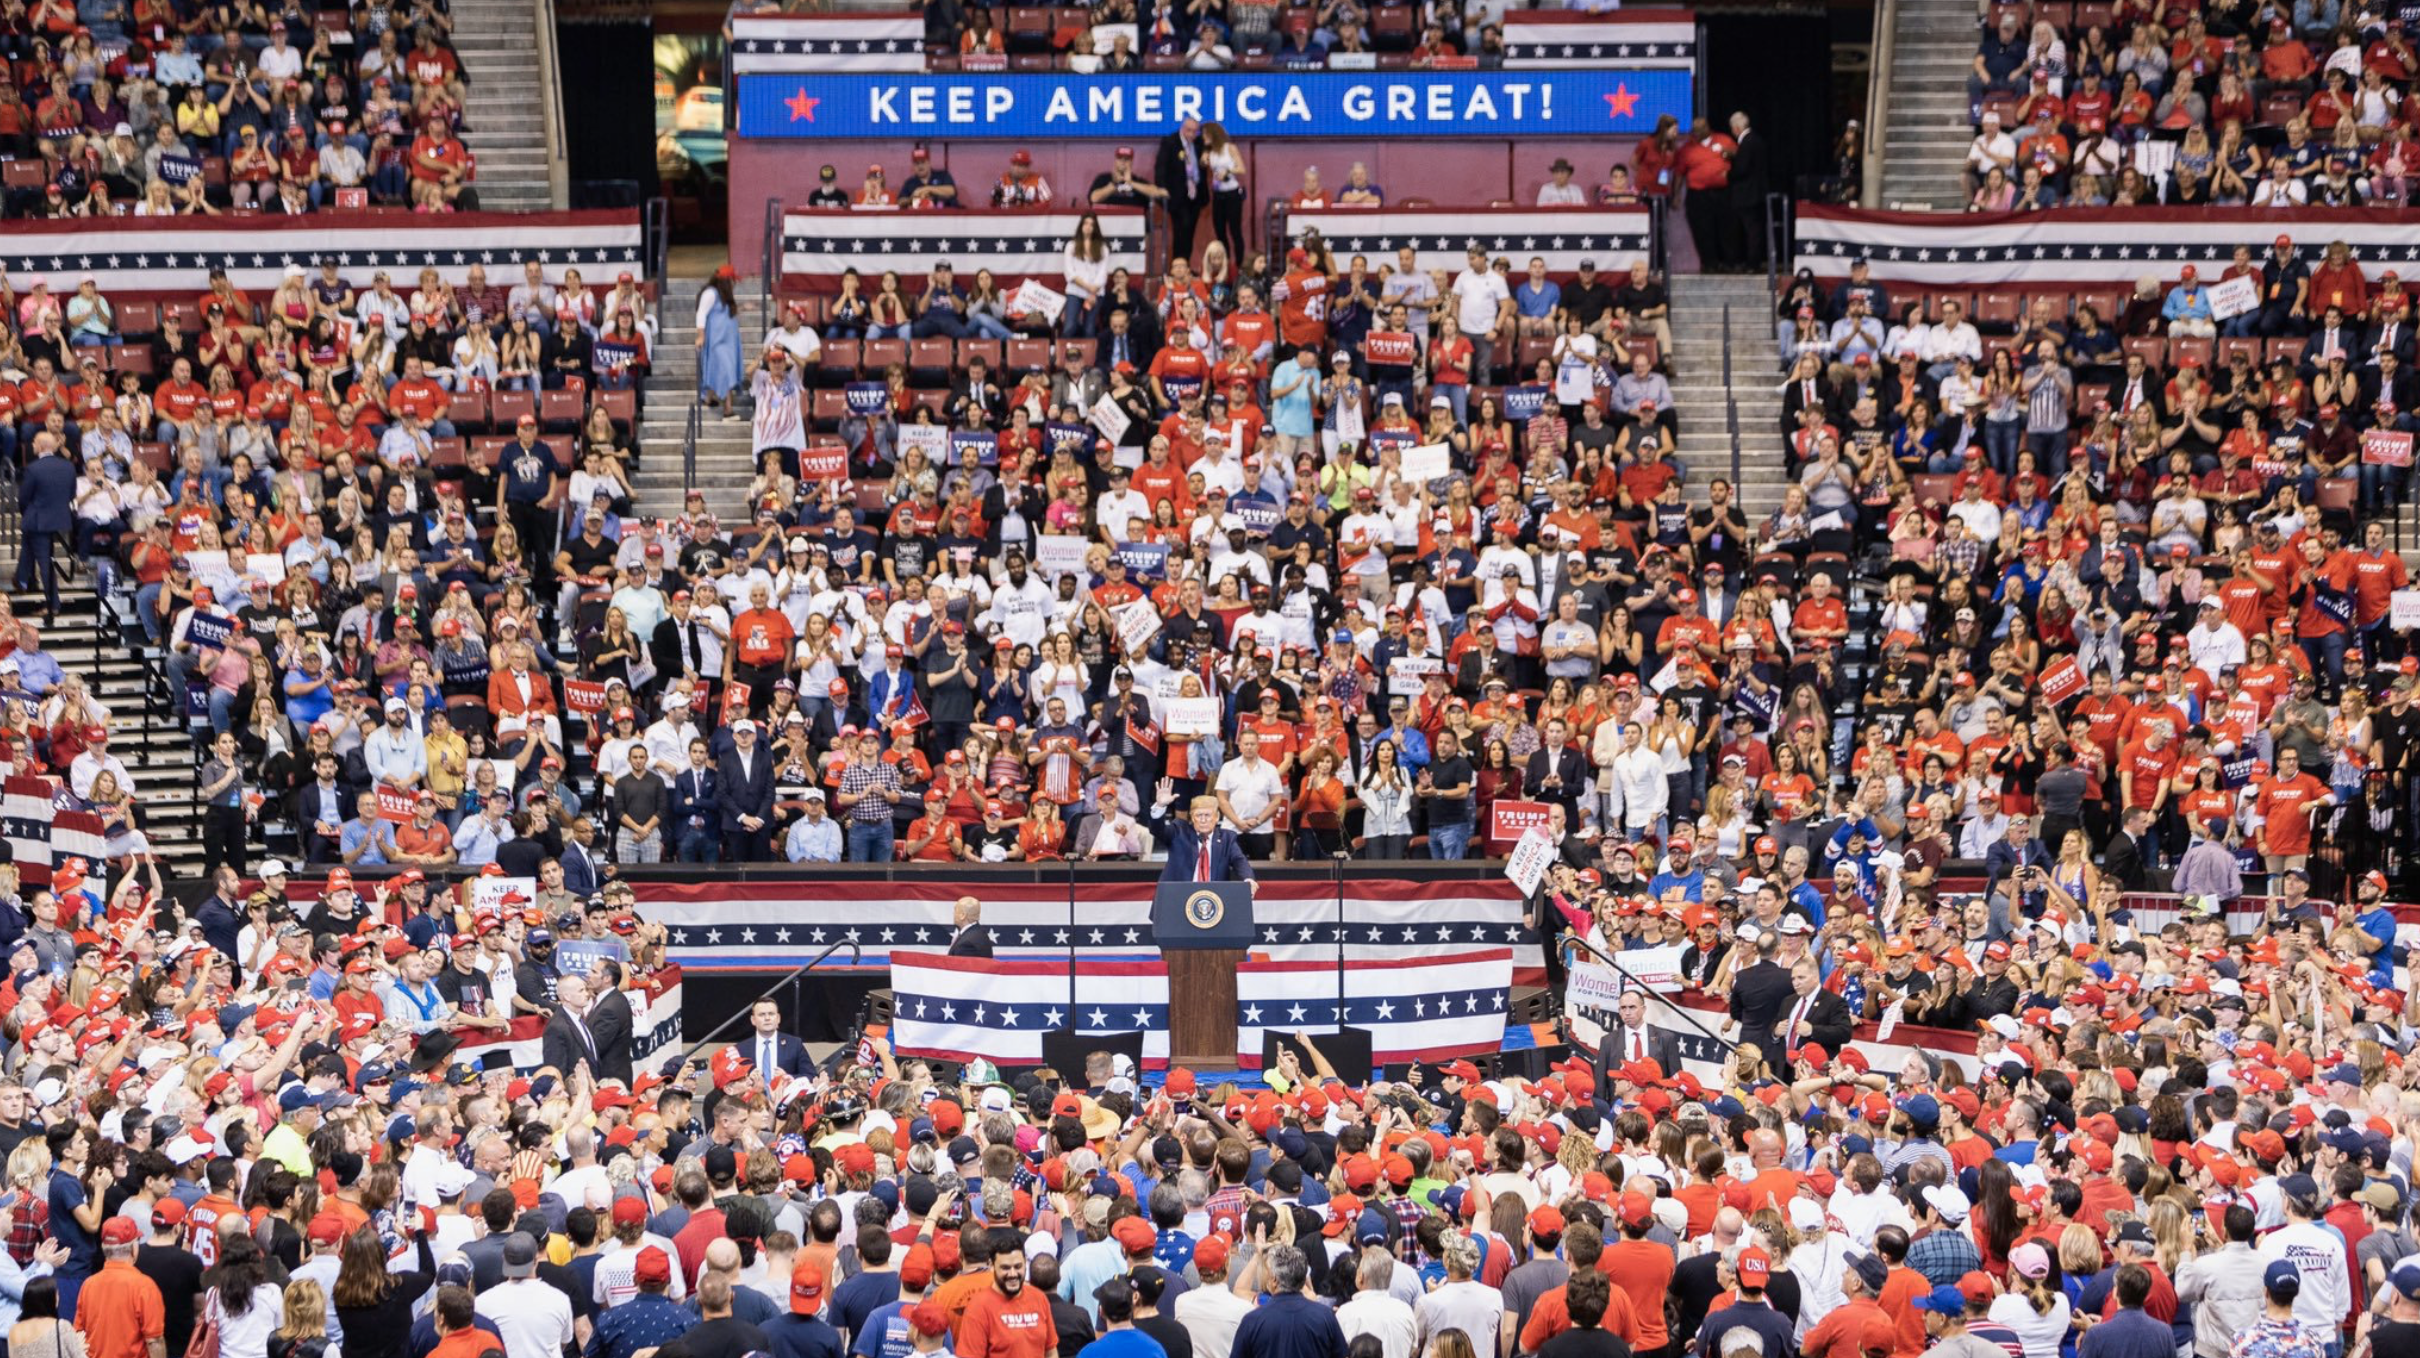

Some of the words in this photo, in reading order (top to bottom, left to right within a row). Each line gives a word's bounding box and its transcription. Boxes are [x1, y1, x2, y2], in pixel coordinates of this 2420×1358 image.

[871, 86, 1013, 122] KEEP
[1045, 85, 1311, 121] AMERICA
[1342, 83, 1551, 120] GREAT!
[163, 160, 199, 175] TRUMP
[1370, 339, 1409, 350] TRUMP
[848, 390, 885, 399] TRUMP
[1507, 393, 1547, 402] TRUMP
[902, 437, 943, 445] AMERICA
[2367, 438, 2408, 450] TRUMP
[804, 455, 844, 466] TRUMP
[1236, 509, 1277, 519] TRUMP
[1040, 545, 1082, 557] Women
[1119, 551, 1161, 559] TRUMP
[1124, 609, 1139, 625] KEEP
[193, 618, 230, 636] TRUMP
[1129, 620, 1152, 642] GREAT!
[446, 669, 487, 680] TRUMP
[2041, 664, 2075, 689] TRUMP
[568, 687, 605, 700] TRUMP
[1171, 708, 1215, 719] Women
[2135, 757, 2163, 768] TRUMP
[2223, 757, 2257, 772] TRUMP
[1498, 811, 1547, 820] TRUMP
[1515, 844, 1527, 867] KEEP
[1518, 843, 1542, 883] AMERICA
[1528, 853, 1543, 884] GREAT!
[494, 885, 519, 894] KEEP
[1574, 973, 1617, 993] Wome
[1578, 988, 1593, 997] FOR
[193, 1210, 218, 1224] TRUMP
[191, 1227, 216, 1265] 45
[1746, 1258, 1766, 1271] USA
[1001, 1312, 1039, 1325] TRUMP
